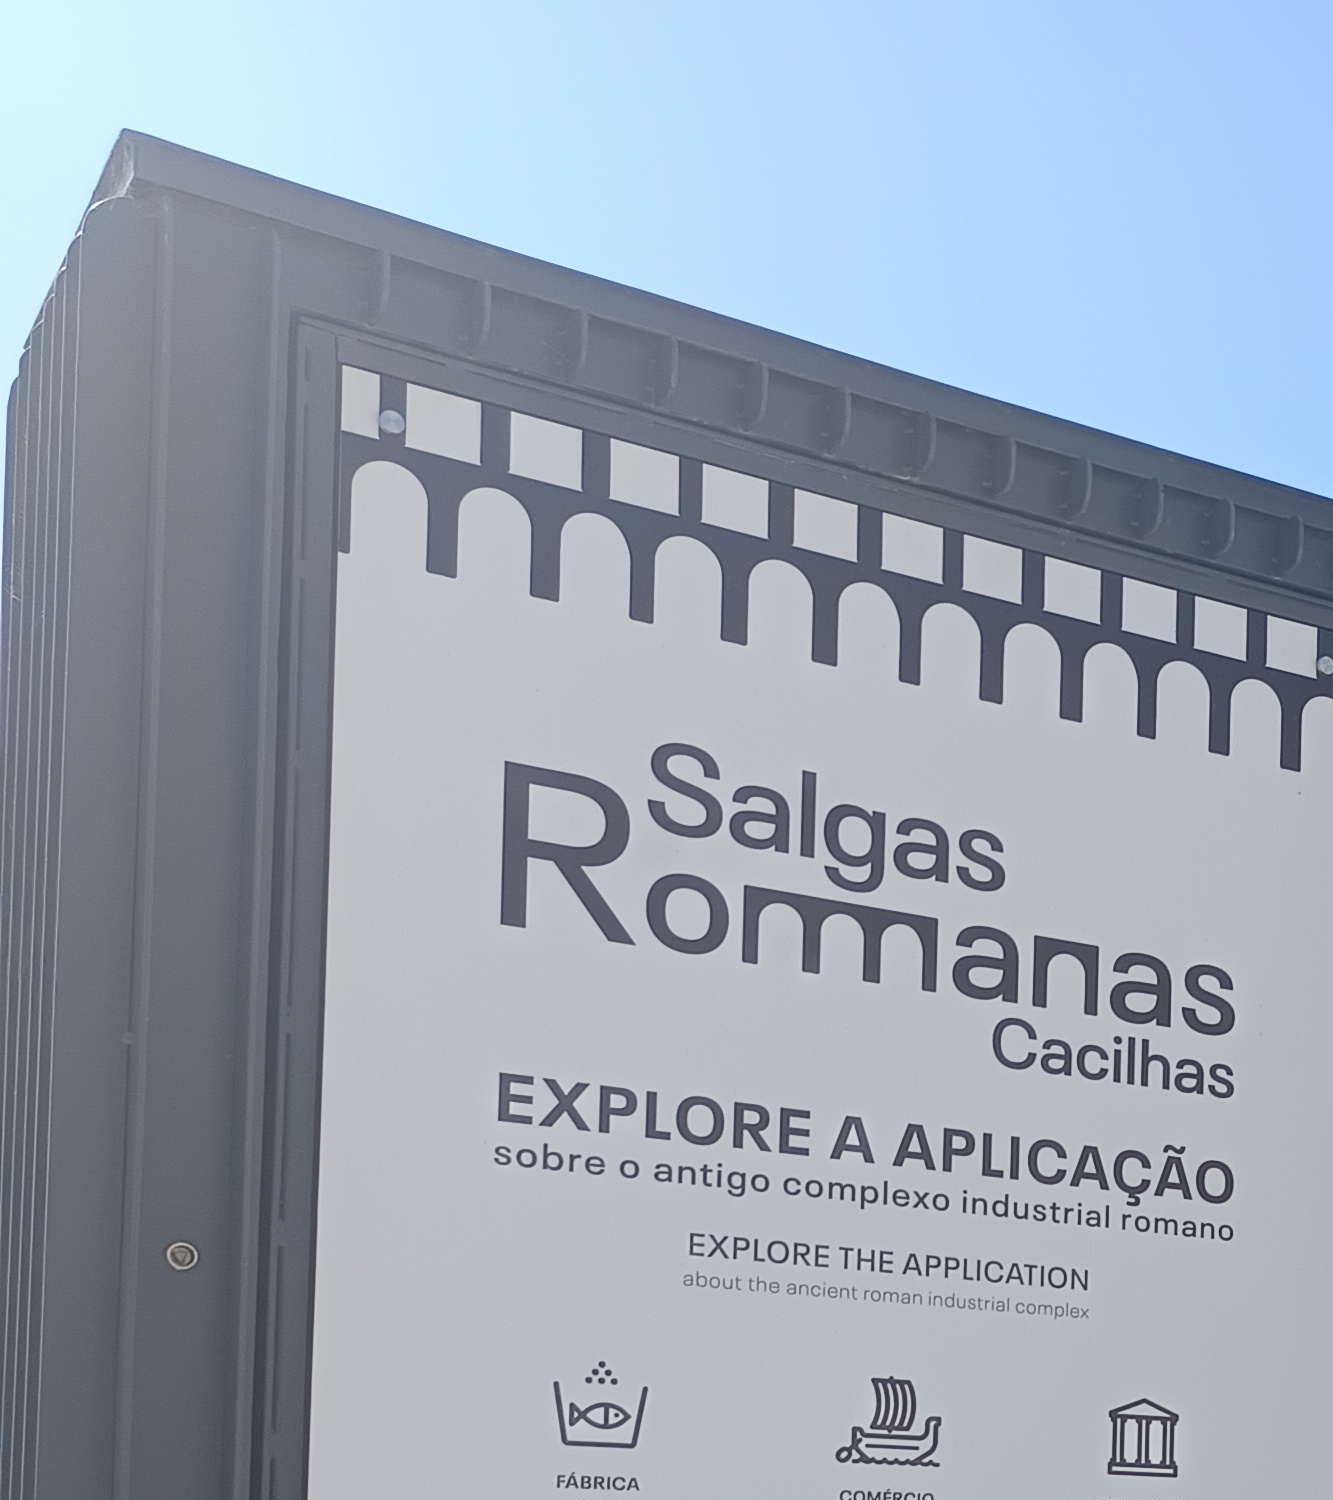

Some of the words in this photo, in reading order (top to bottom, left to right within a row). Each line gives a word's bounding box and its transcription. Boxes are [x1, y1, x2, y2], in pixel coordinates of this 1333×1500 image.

[647, 742, 1006, 893] Salgas
[499, 760, 1236, 1037] Romanas
[992, 1017, 1234, 1099] Cacilhas
[497, 1072, 811, 1156] EXPLORE
[829, 1115, 875, 1164] A
[892, 1123, 1234, 1207] APLICAÇÃO
[494, 1143, 605, 1175] sobre
[619, 1160, 640, 1179] o
[654, 1163, 770, 1197] antigo
[783, 1177, 950, 1211] complexo
[962, 1189, 1110, 1228] industrial
[1122, 1214, 1234, 1241] romano
[683, 1271, 742, 1291] about
[749, 1276, 780, 1294] the
[786, 1283, 857, 1300] ancient
[864, 1290, 922, 1305] roman
[928, 1293, 1010, 1312] industrial
[1015, 1302, 1089, 1320] complex
[689, 1232, 830, 1268] EXPLORE
[839, 1246, 894, 1274] THE
[902, 1253, 1088, 1291] APPLICATION
[556, 1472, 640, 1491] FÁBRICA
